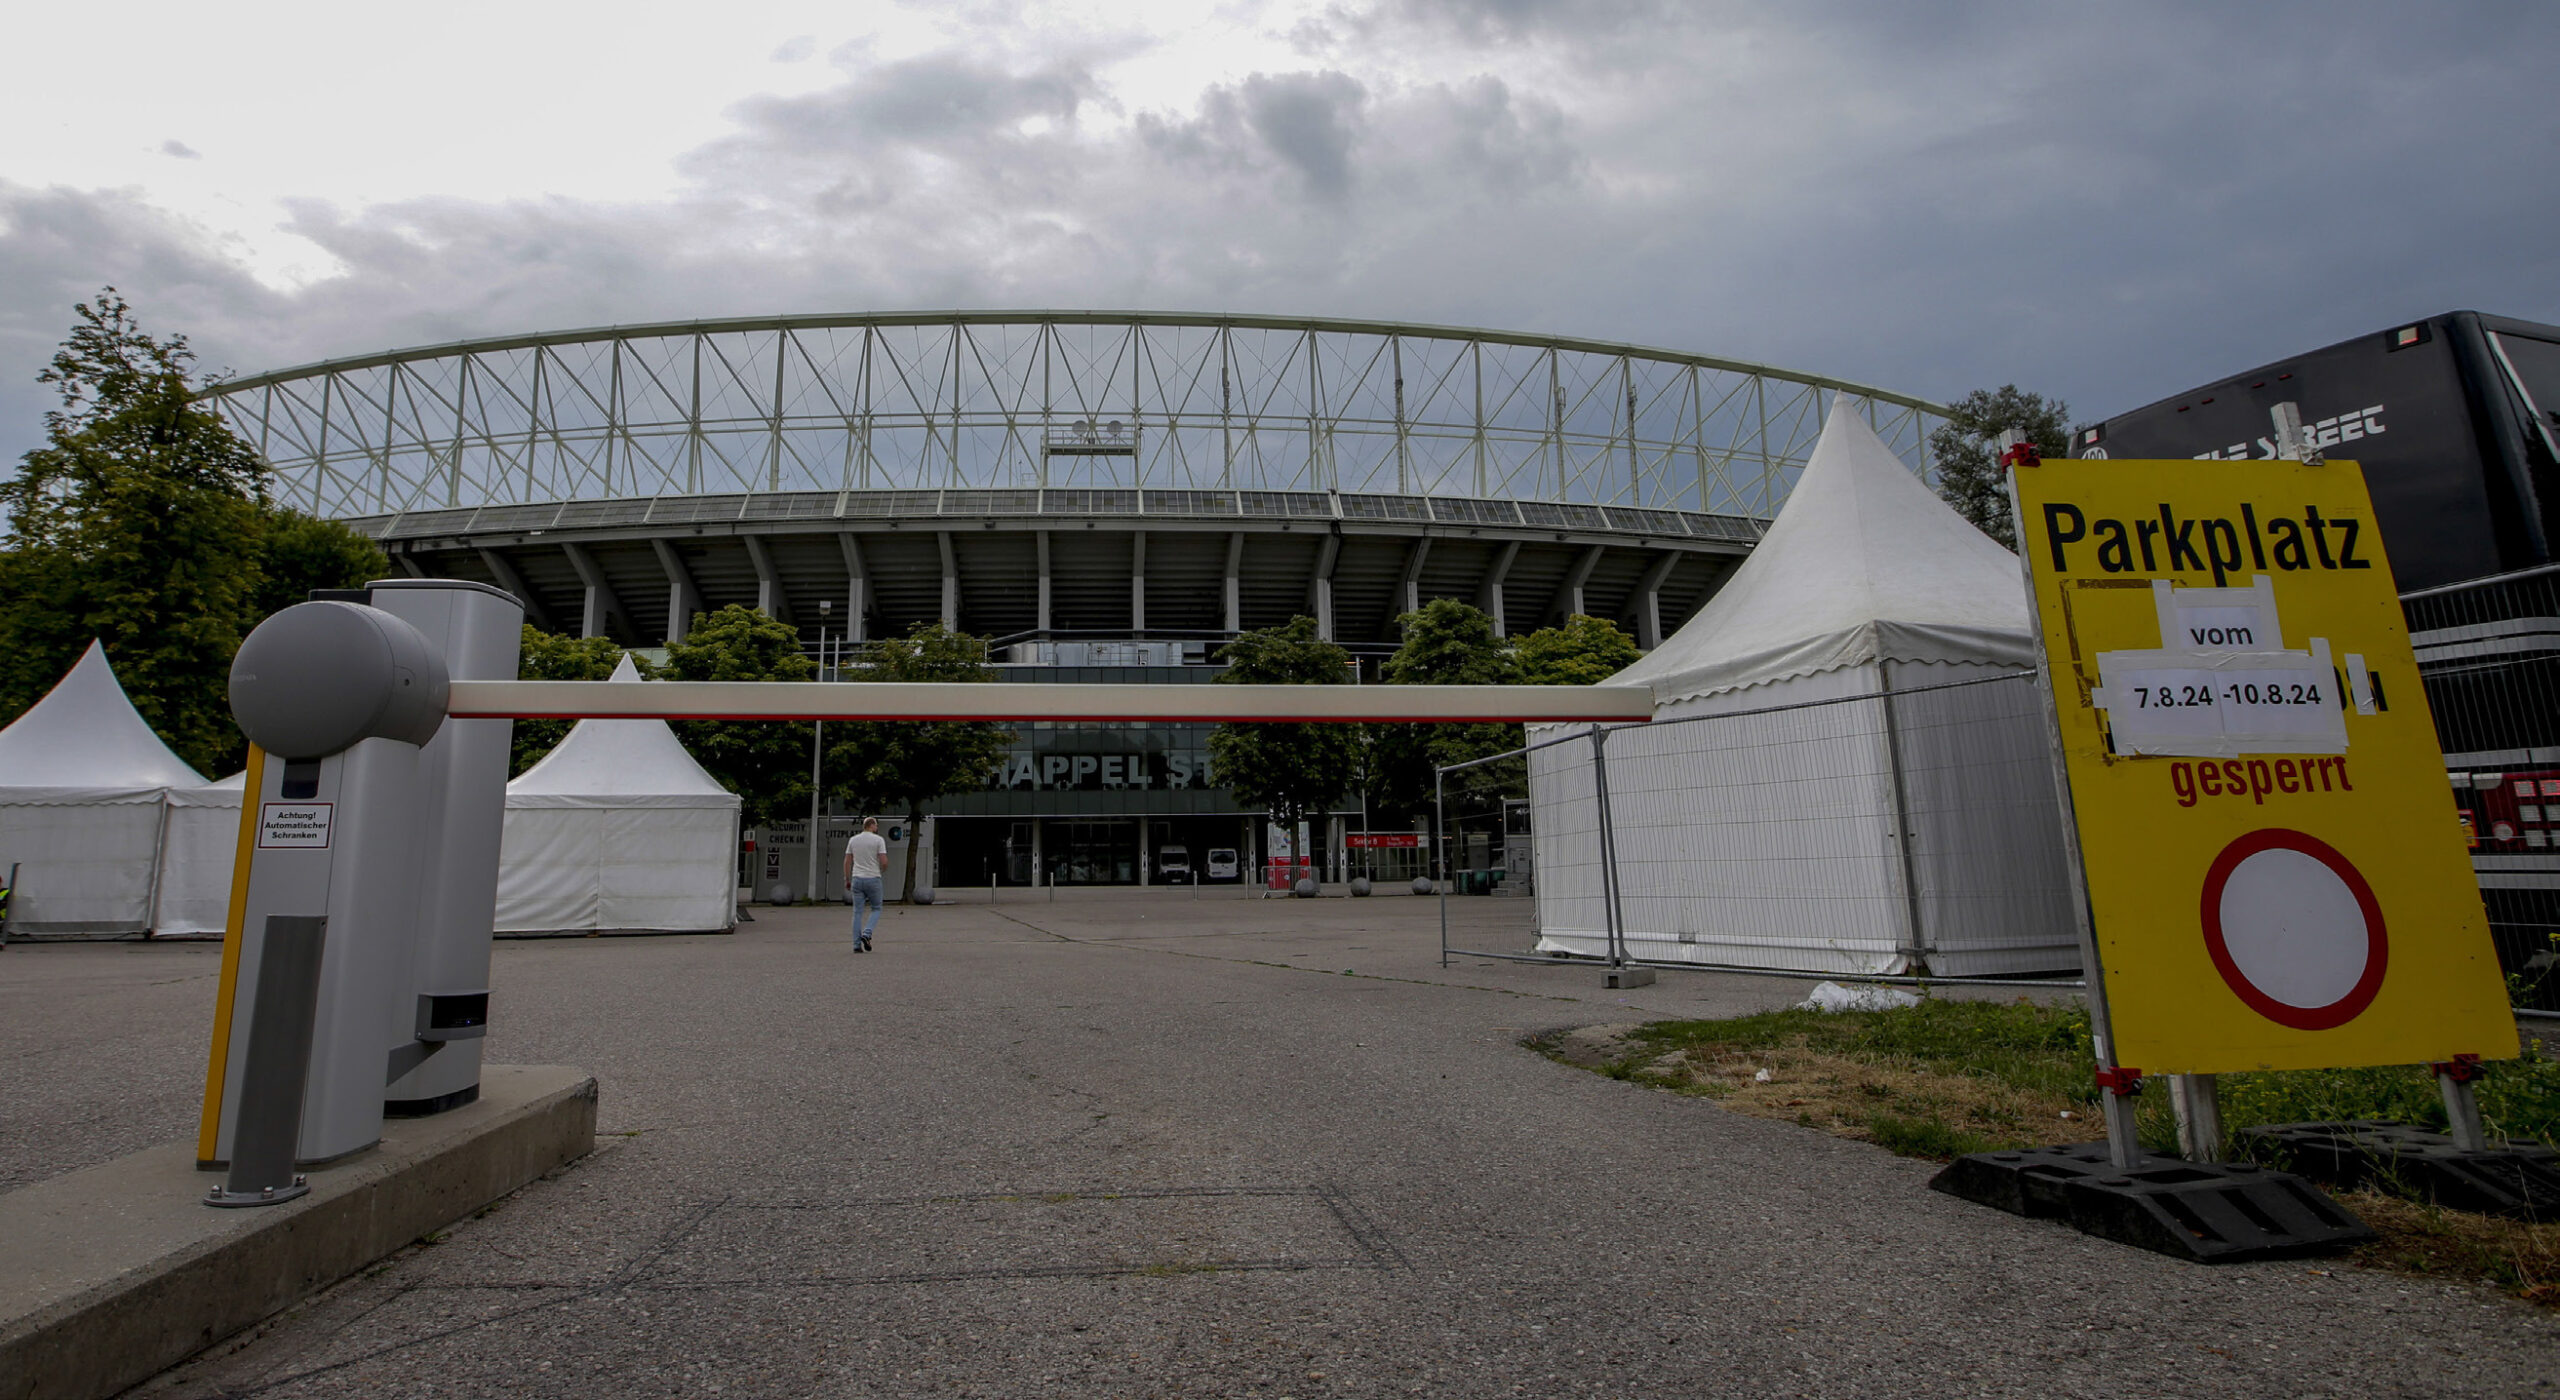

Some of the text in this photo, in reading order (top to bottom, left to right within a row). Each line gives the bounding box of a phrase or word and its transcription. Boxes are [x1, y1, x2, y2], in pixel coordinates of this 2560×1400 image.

[2257, 405, 2387, 459] SREET
[2043, 503, 2371, 588] Parkplatz
[2190, 627, 2253, 645] vom
[2134, 685, 2213, 708] 7.8.24
[2223, 683, 2321, 705] -10.8.24
[2171, 755, 2353, 807] gesperrt
[277, 811, 317, 820] Achtung!
[769, 835, 794, 844] CHECK
